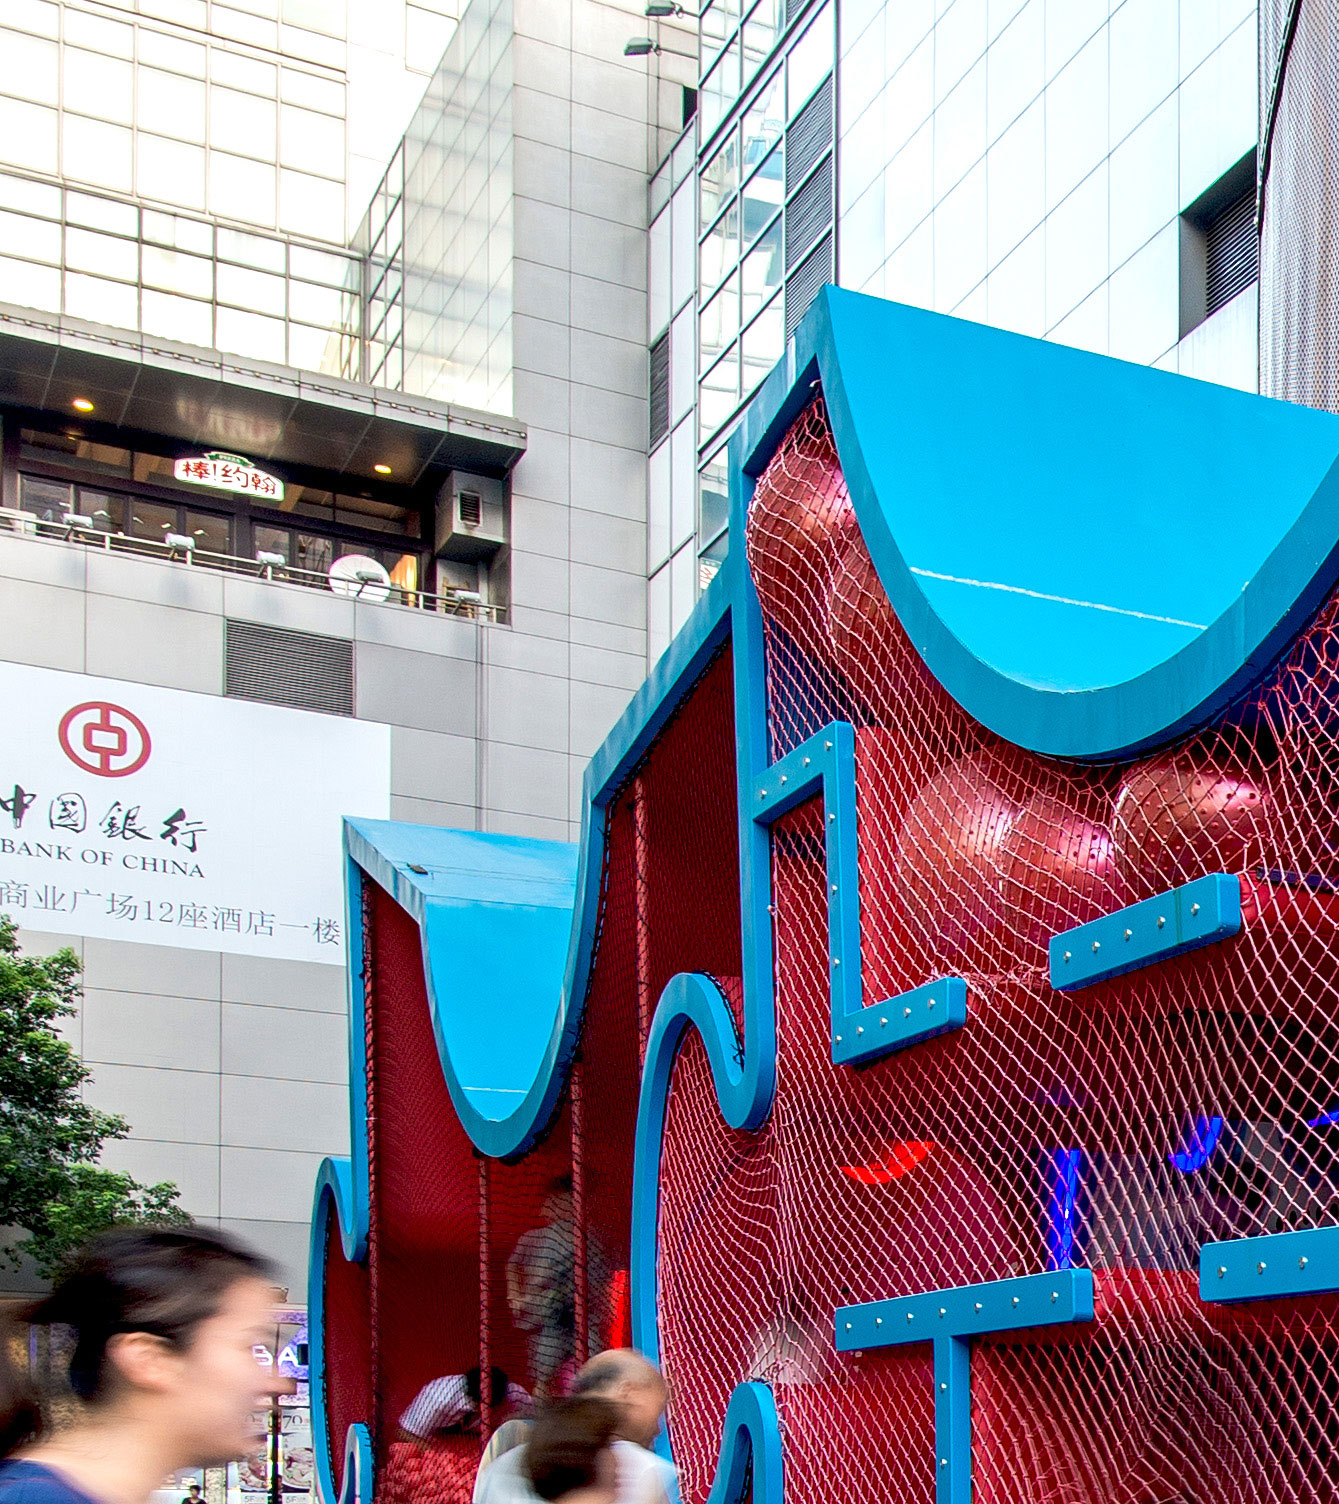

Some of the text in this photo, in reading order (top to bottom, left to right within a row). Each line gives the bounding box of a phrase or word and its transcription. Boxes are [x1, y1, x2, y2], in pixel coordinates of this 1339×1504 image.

[1, 838, 205, 878] BANK OF CHINA
